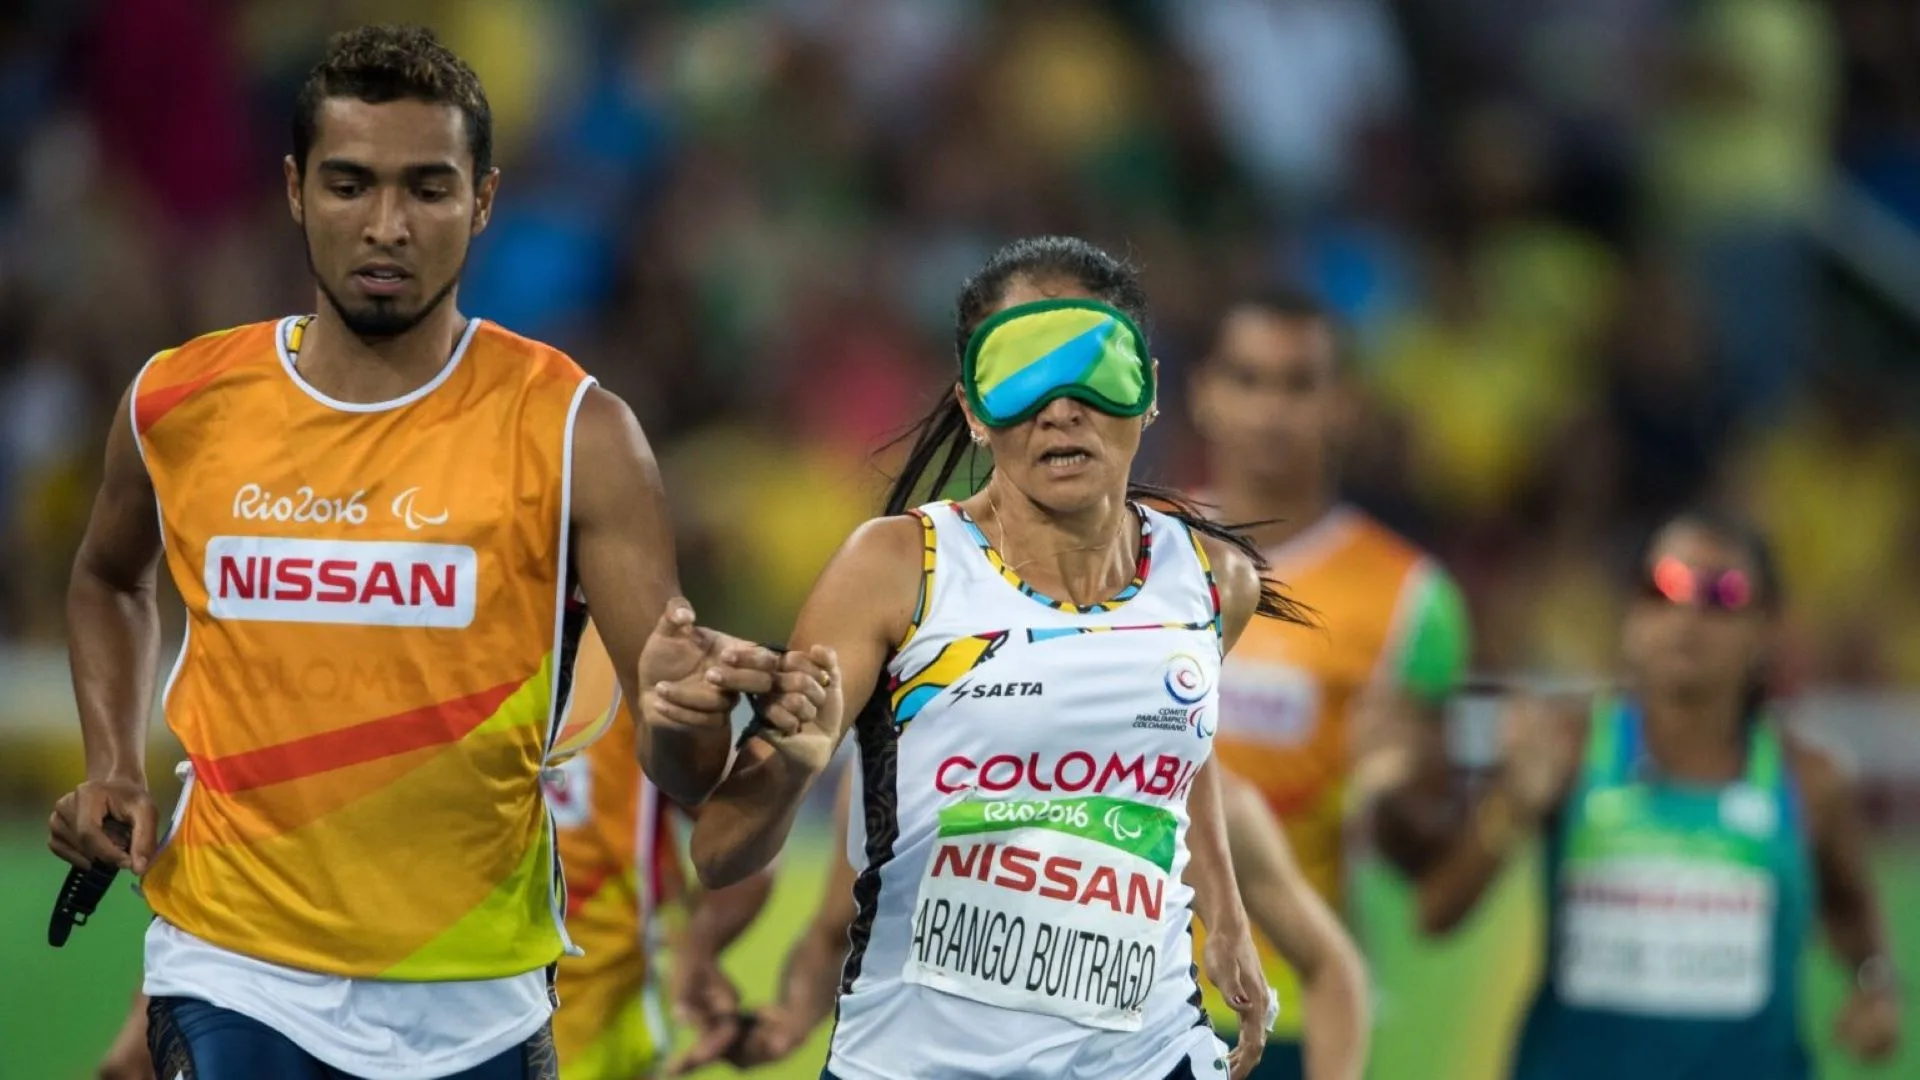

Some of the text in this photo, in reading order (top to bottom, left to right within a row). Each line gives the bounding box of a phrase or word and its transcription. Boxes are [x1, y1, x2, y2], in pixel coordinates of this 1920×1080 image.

[233, 483, 368, 525] Rio2016
[219, 556, 457, 607] NISSAN
[972, 682, 1043, 699] SAETA
[984, 801, 1090, 828] Rio2016
[931, 843, 1164, 921] NISSAN
[914, 898, 1026, 985] ARANGO
